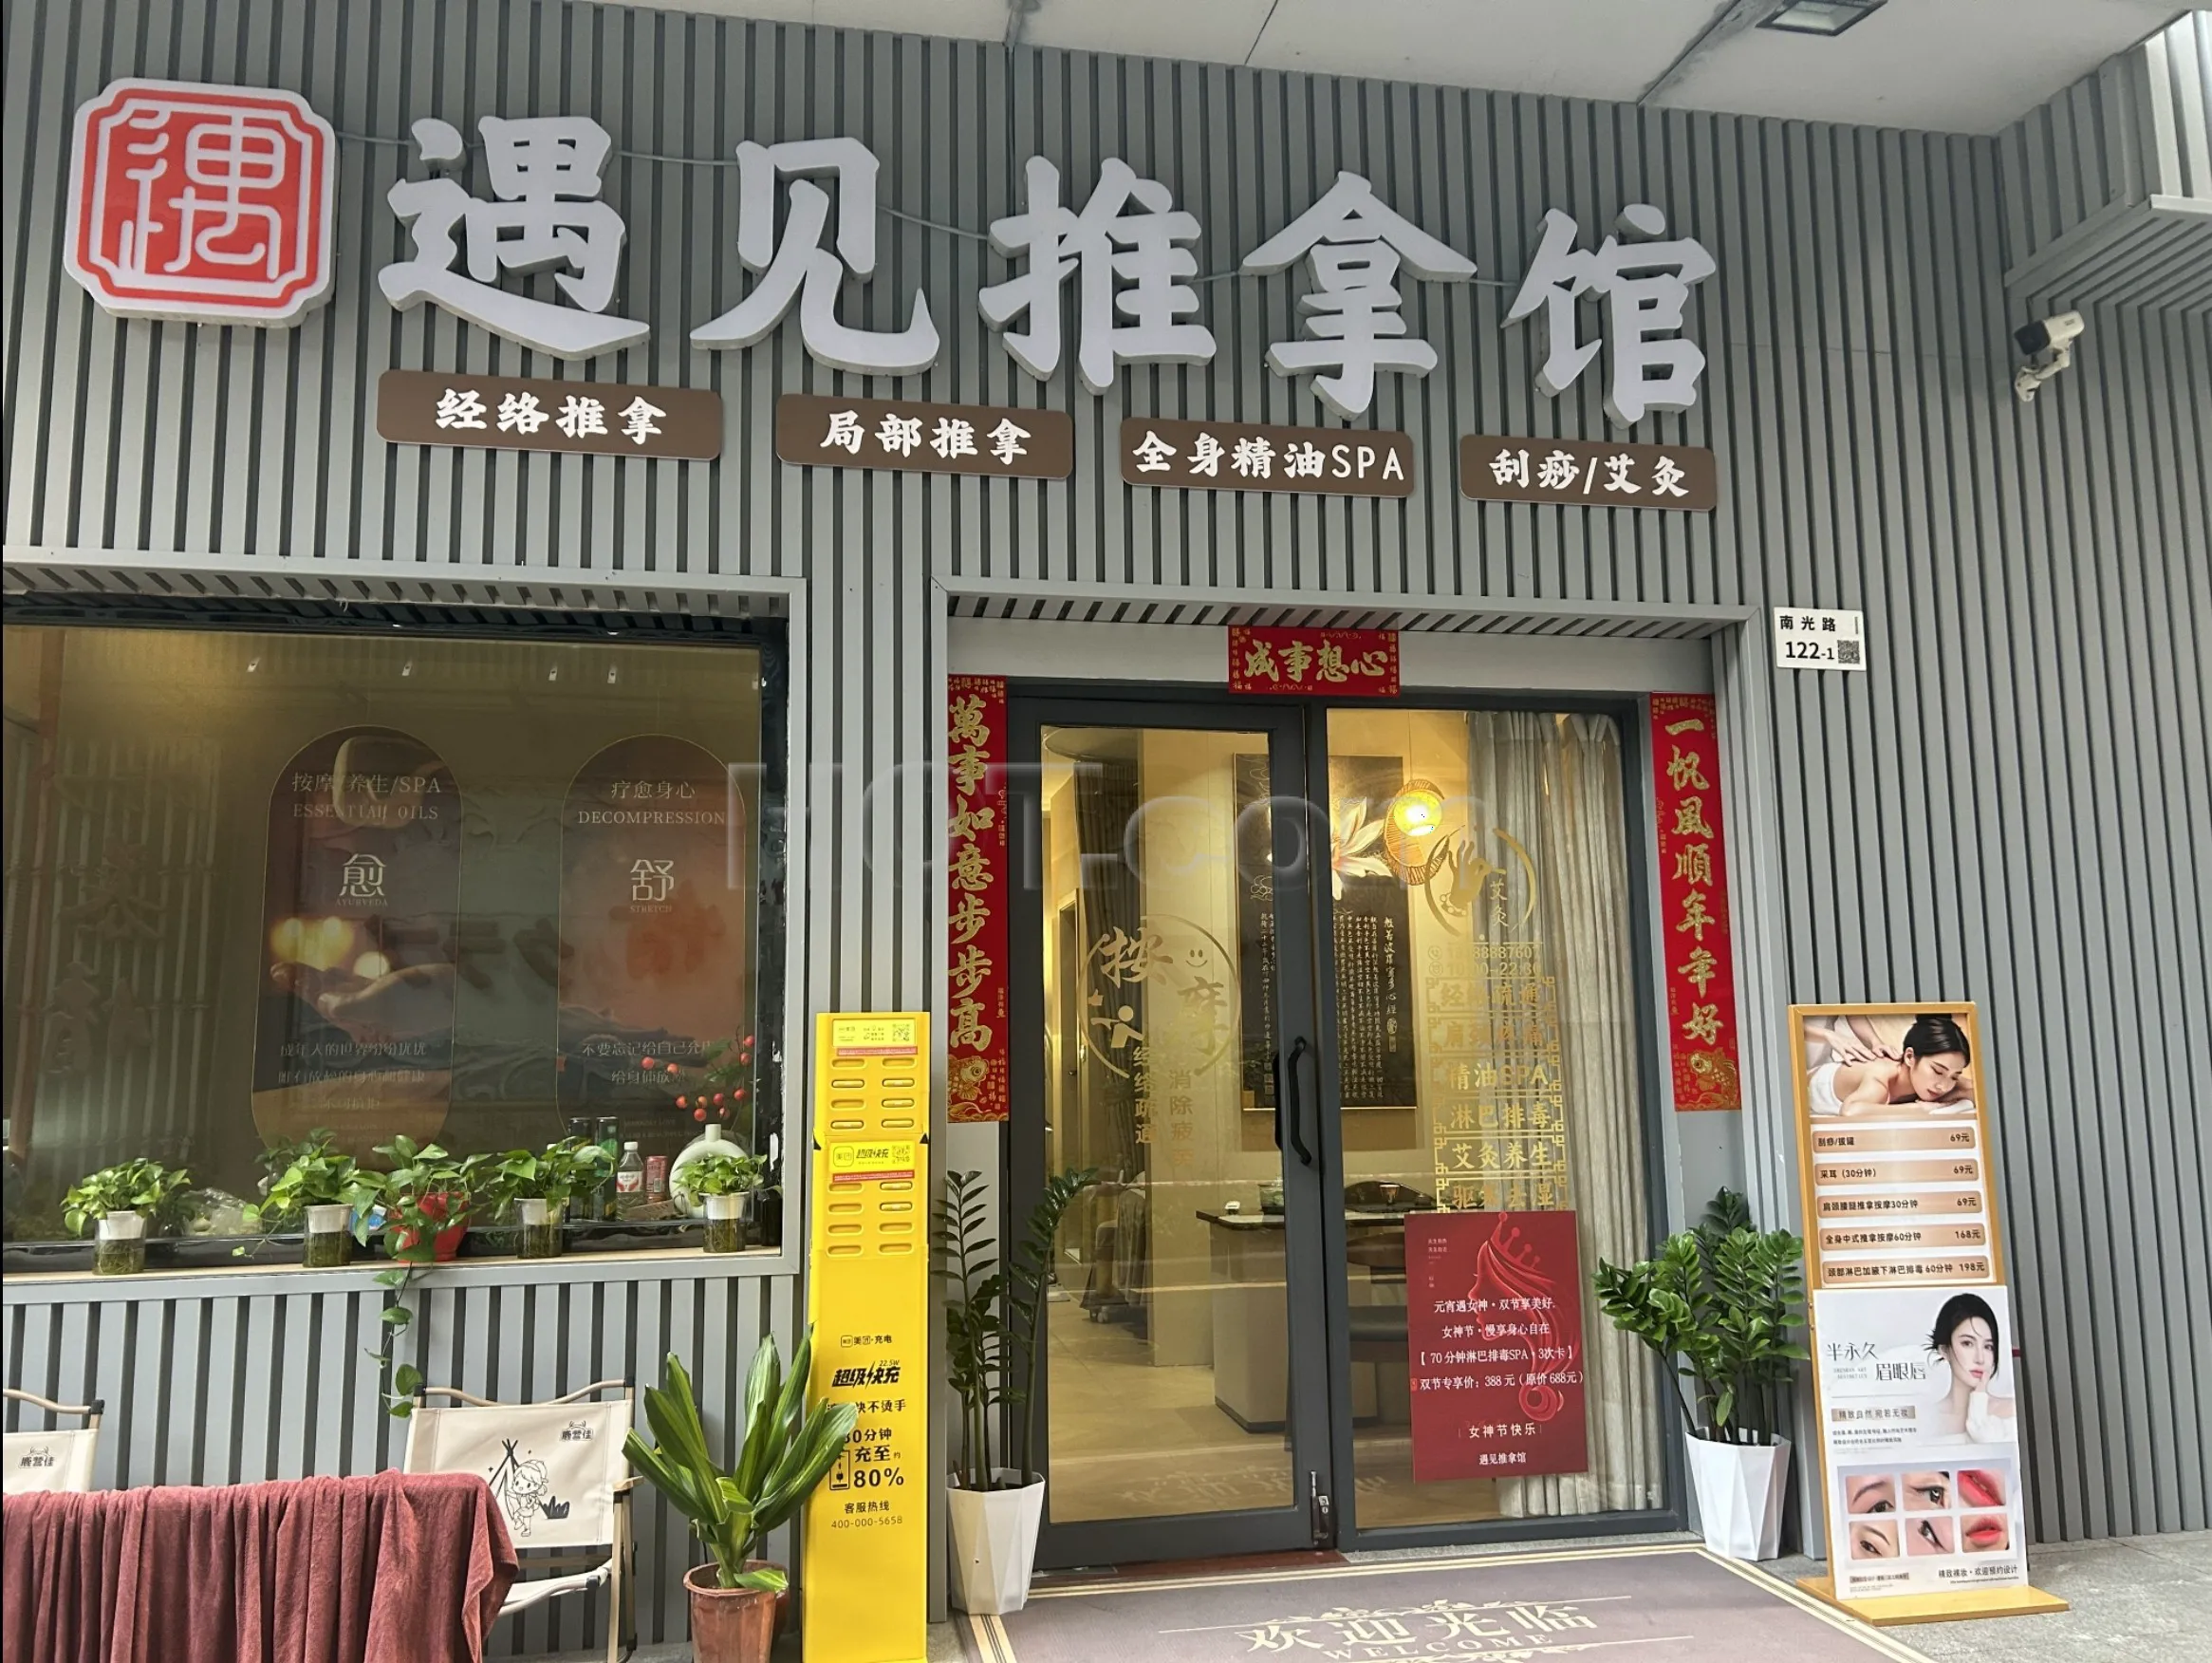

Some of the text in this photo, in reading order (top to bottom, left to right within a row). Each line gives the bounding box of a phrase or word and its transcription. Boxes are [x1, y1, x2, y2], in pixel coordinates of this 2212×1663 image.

[379, 116, 1716, 429] 遇见推拿馆
[436, 389, 667, 445] 经络推拿
[820, 410, 1032, 462] 局部推拿
[1132, 433, 1404, 485] 全身精油SPA
[1487, 448, 1690, 497] 刮痧/艾灸
[1779, 615, 1835, 631] 南光路
[1785, 642, 1834, 660] 122-1
[610, 779, 696, 799] 疗愈身心
[398, 805, 439, 819] OILS
[578, 811, 726, 824] DECOMPRESSION
[340, 853, 386, 897] 愈
[630, 859, 675, 902] 舒
[1490, 878, 1509, 927] 艾灸
[1449, 1062, 1549, 1090] 精油SPA
[1450, 1101, 1552, 1129] 淋巴排毒
[1949, 1132, 1970, 1143] 69元
[1452, 1142, 1552, 1168] 艾灸养生
[1953, 1165, 1974, 1175] 69元
[1956, 1196, 1977, 1207] 69元
[1955, 1228, 1981, 1241] 168元
[1958, 1261, 1985, 1273] 198元
[1827, 1342, 1879, 1361] 半永久
[832, 1366, 901, 1388] 超级快充
[1876, 1362, 1926, 1380] 眉眼唇
[1468, 1423, 1536, 1439] 女神节快乐
[1479, 1451, 1527, 1466] 遇见推拿馆
[853, 1467, 904, 1488] 80%
[845, 1501, 890, 1515] 客服热线
[831, 1515, 903, 1529] 400-000-5658
[1235, 1605, 1598, 1653] 欢迎光临
[1322, 1633, 1554, 1660] WELCOME
